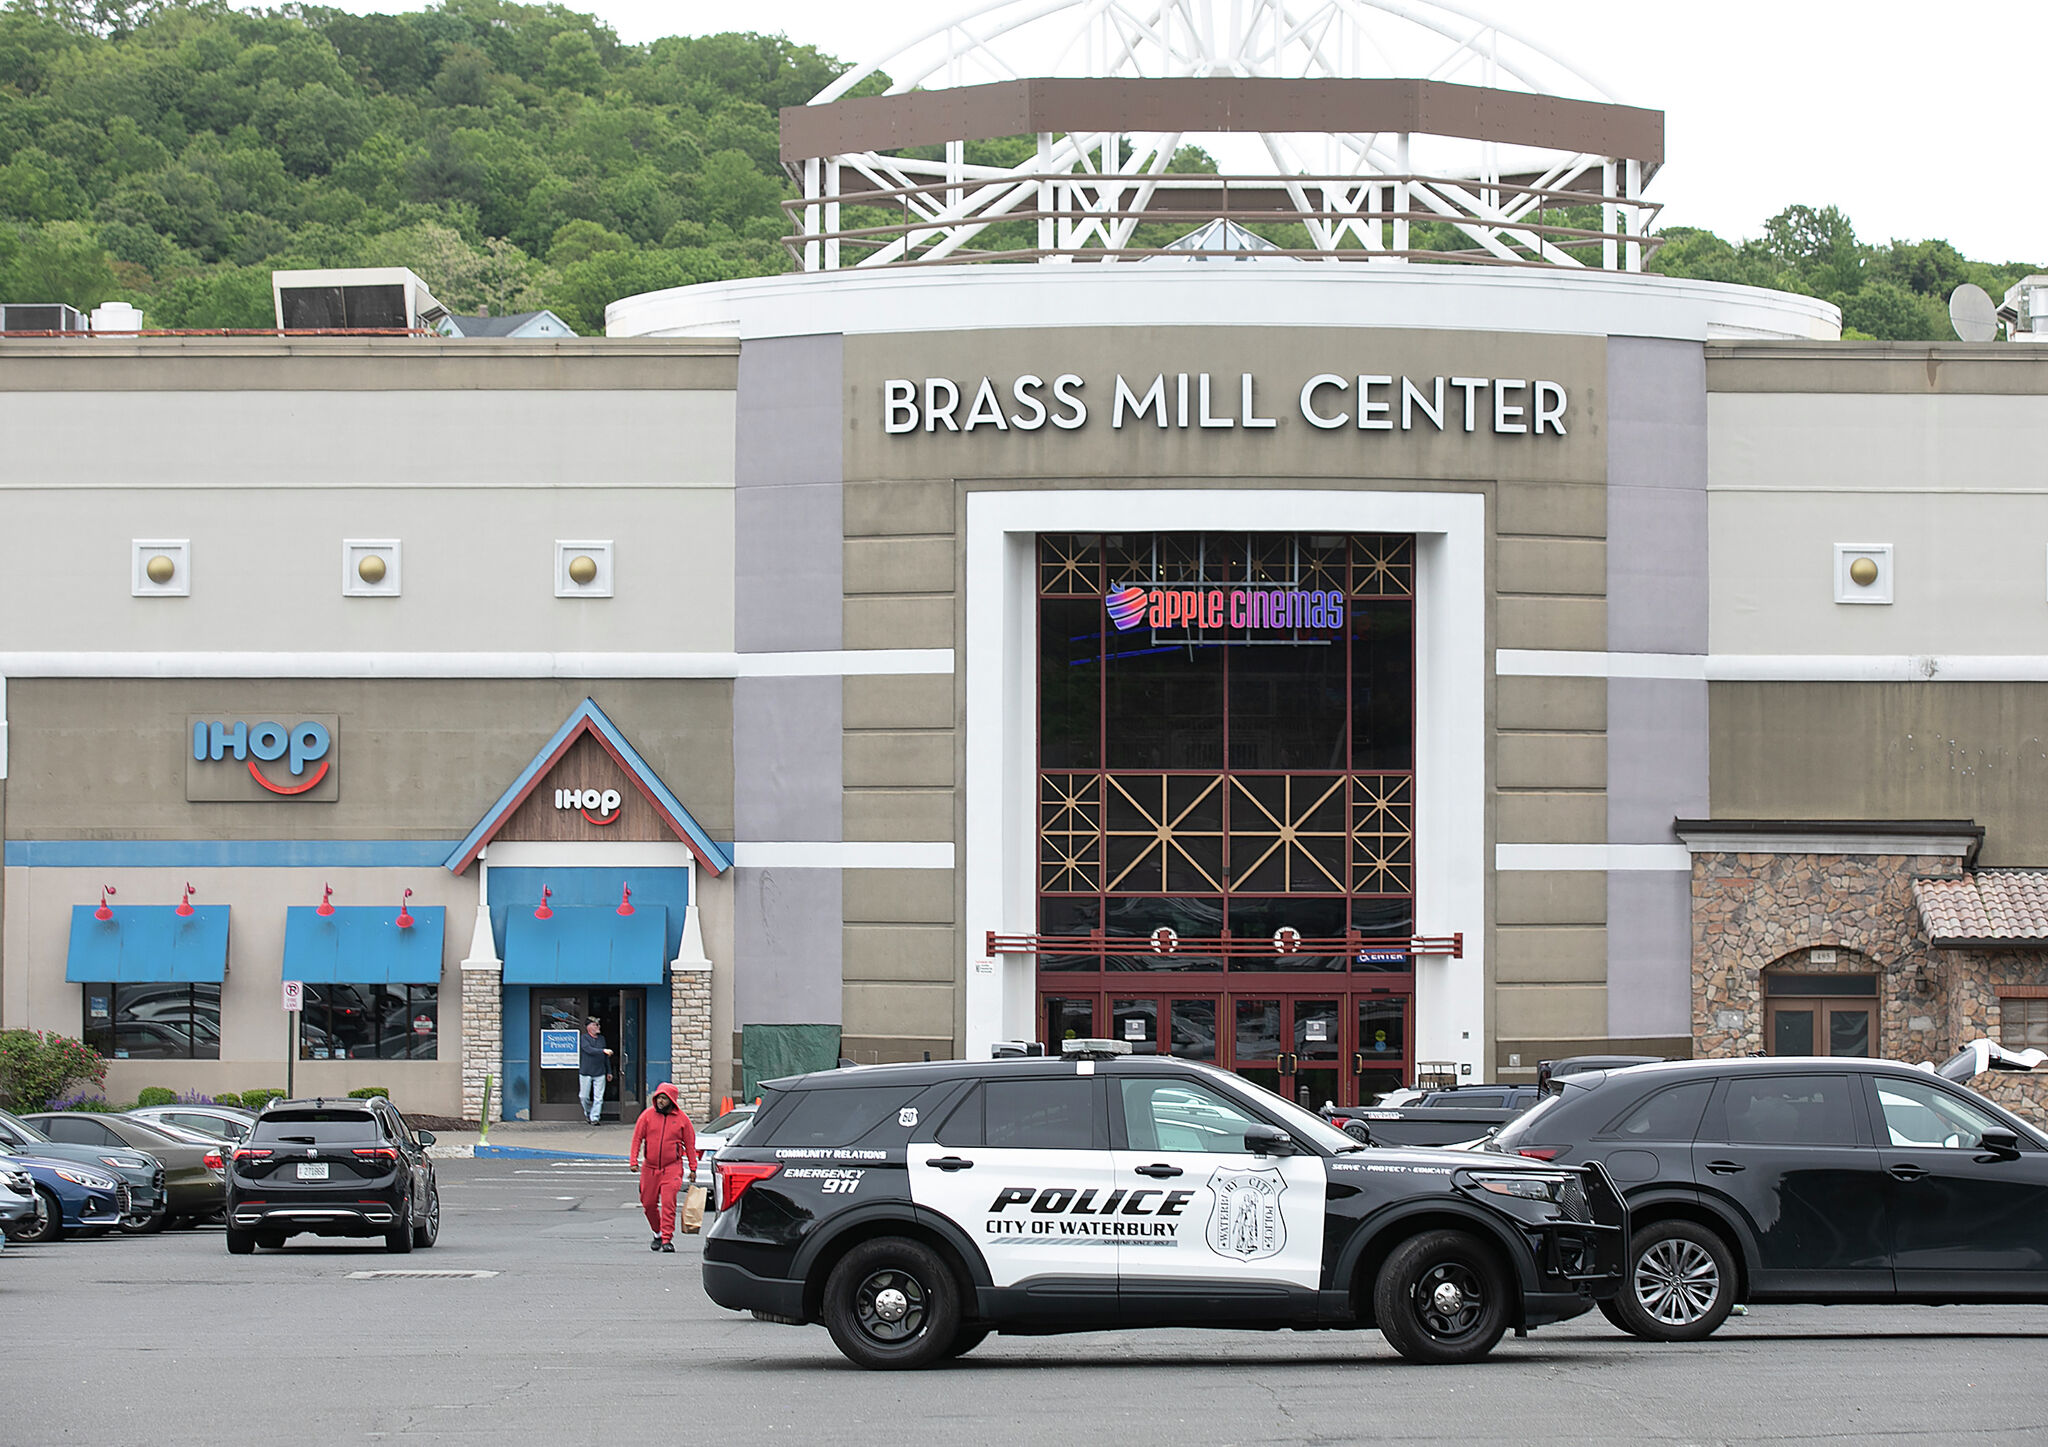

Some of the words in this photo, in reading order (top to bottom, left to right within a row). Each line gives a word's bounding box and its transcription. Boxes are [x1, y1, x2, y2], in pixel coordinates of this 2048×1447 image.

[884, 373, 1088, 434] BRASS
[1112, 372, 1277, 429] MILL
[1299, 373, 1568, 435] CENTER
[1149, 590, 1224, 629] apple
[1230, 590, 1344, 629] cinemas
[775, 1149, 832, 1160] COMMUNITY
[833, 1150, 888, 1160] RELATIONS
[783, 1168, 866, 1179] EMERGENCY
[1331, 1163, 1361, 1172] SERVE
[1367, 1164, 1406, 1173] PROTECT
[1412, 1166, 1453, 1176] EDUCATE
[821, 1178, 860, 1194] 911
[1248, 1178, 1274, 1197] CITY
[988, 1187, 1197, 1216] POLICE
[986, 1220, 1026, 1234] CITY
[1031, 1221, 1055, 1235] OF
[1059, 1221, 1180, 1237] WATERBURY
